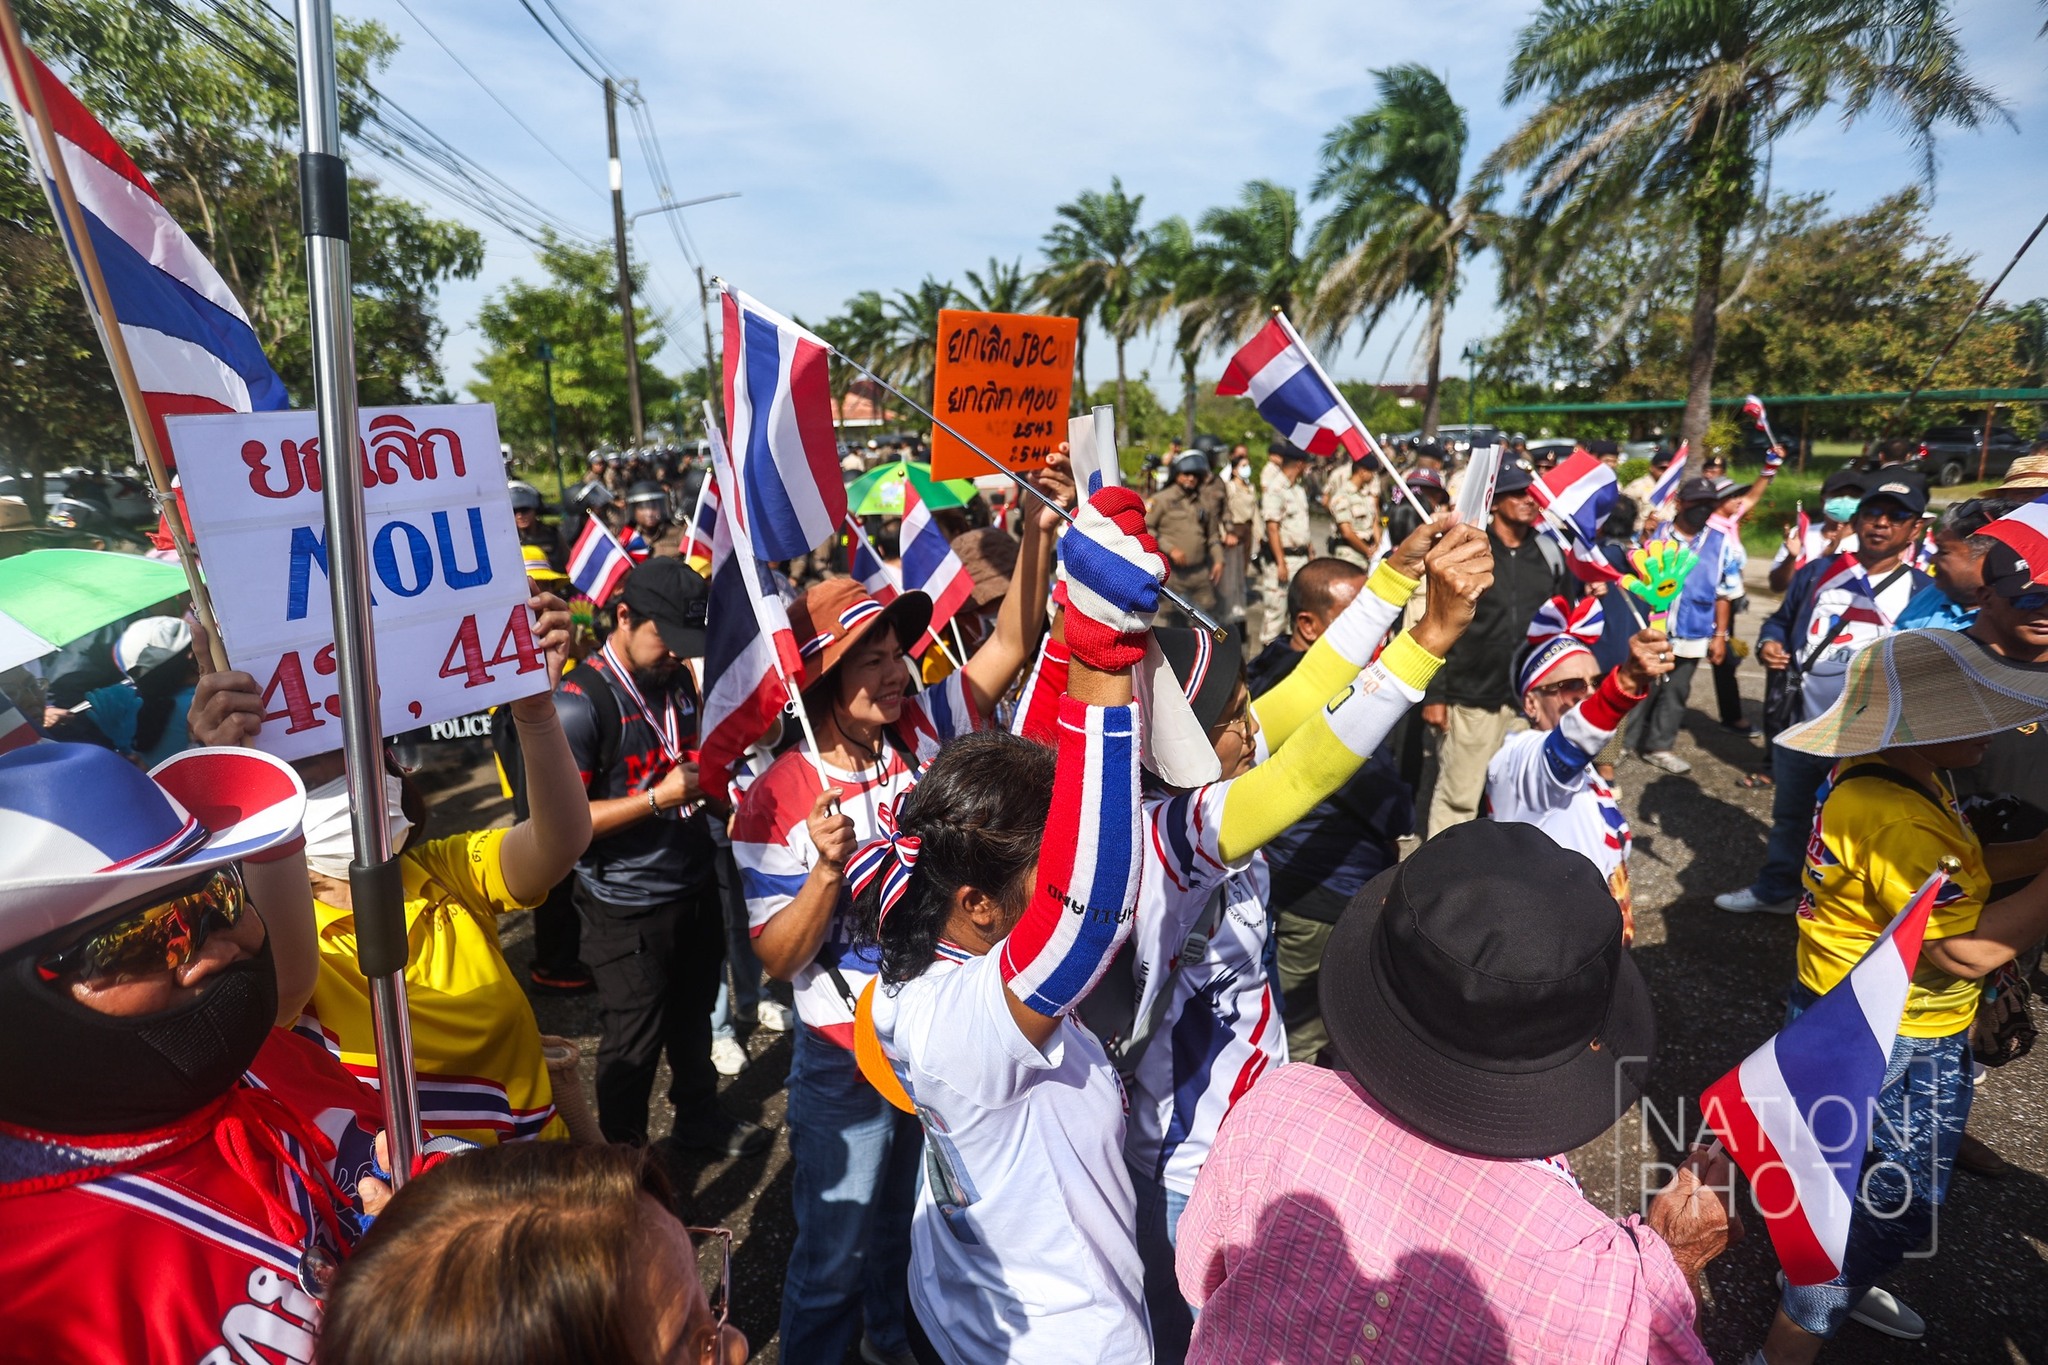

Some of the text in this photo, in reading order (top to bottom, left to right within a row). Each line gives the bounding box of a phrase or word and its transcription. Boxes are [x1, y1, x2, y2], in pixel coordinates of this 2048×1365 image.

[948, 324, 1057, 368] ยกเลิก JBC
[948, 381, 1057, 416] ยกเลิก MOU
[1013, 420, 1053, 439] 2543
[286, 507, 493, 621] MOU
[438, 603, 545, 689] 44
